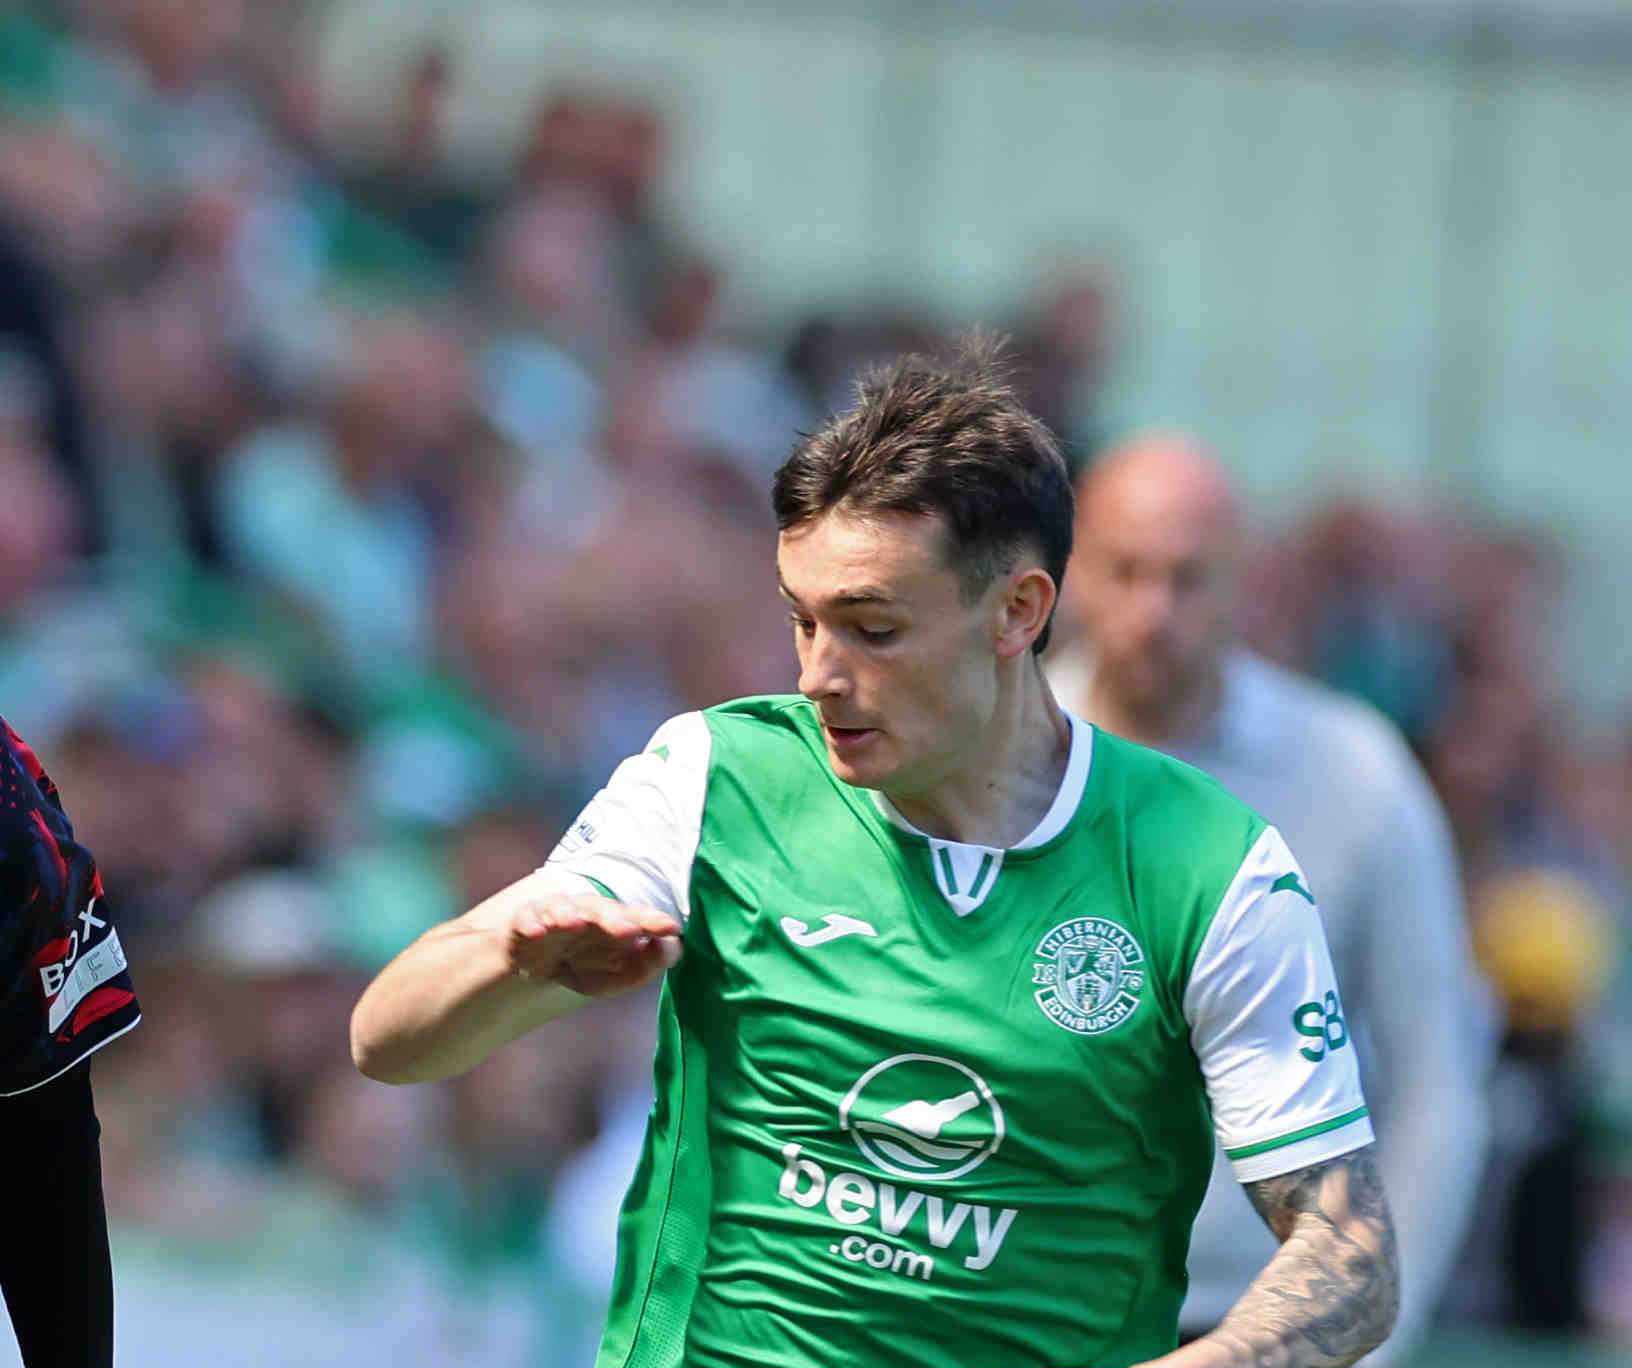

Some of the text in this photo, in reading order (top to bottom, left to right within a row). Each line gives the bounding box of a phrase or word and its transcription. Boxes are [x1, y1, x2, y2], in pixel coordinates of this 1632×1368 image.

[1044, 921, 1137, 957] HIBERNIAN
[1042, 996, 1130, 1031] EDINBURGH
[778, 1142, 1018, 1270] bevvy
[829, 1235, 935, 1280] .com
